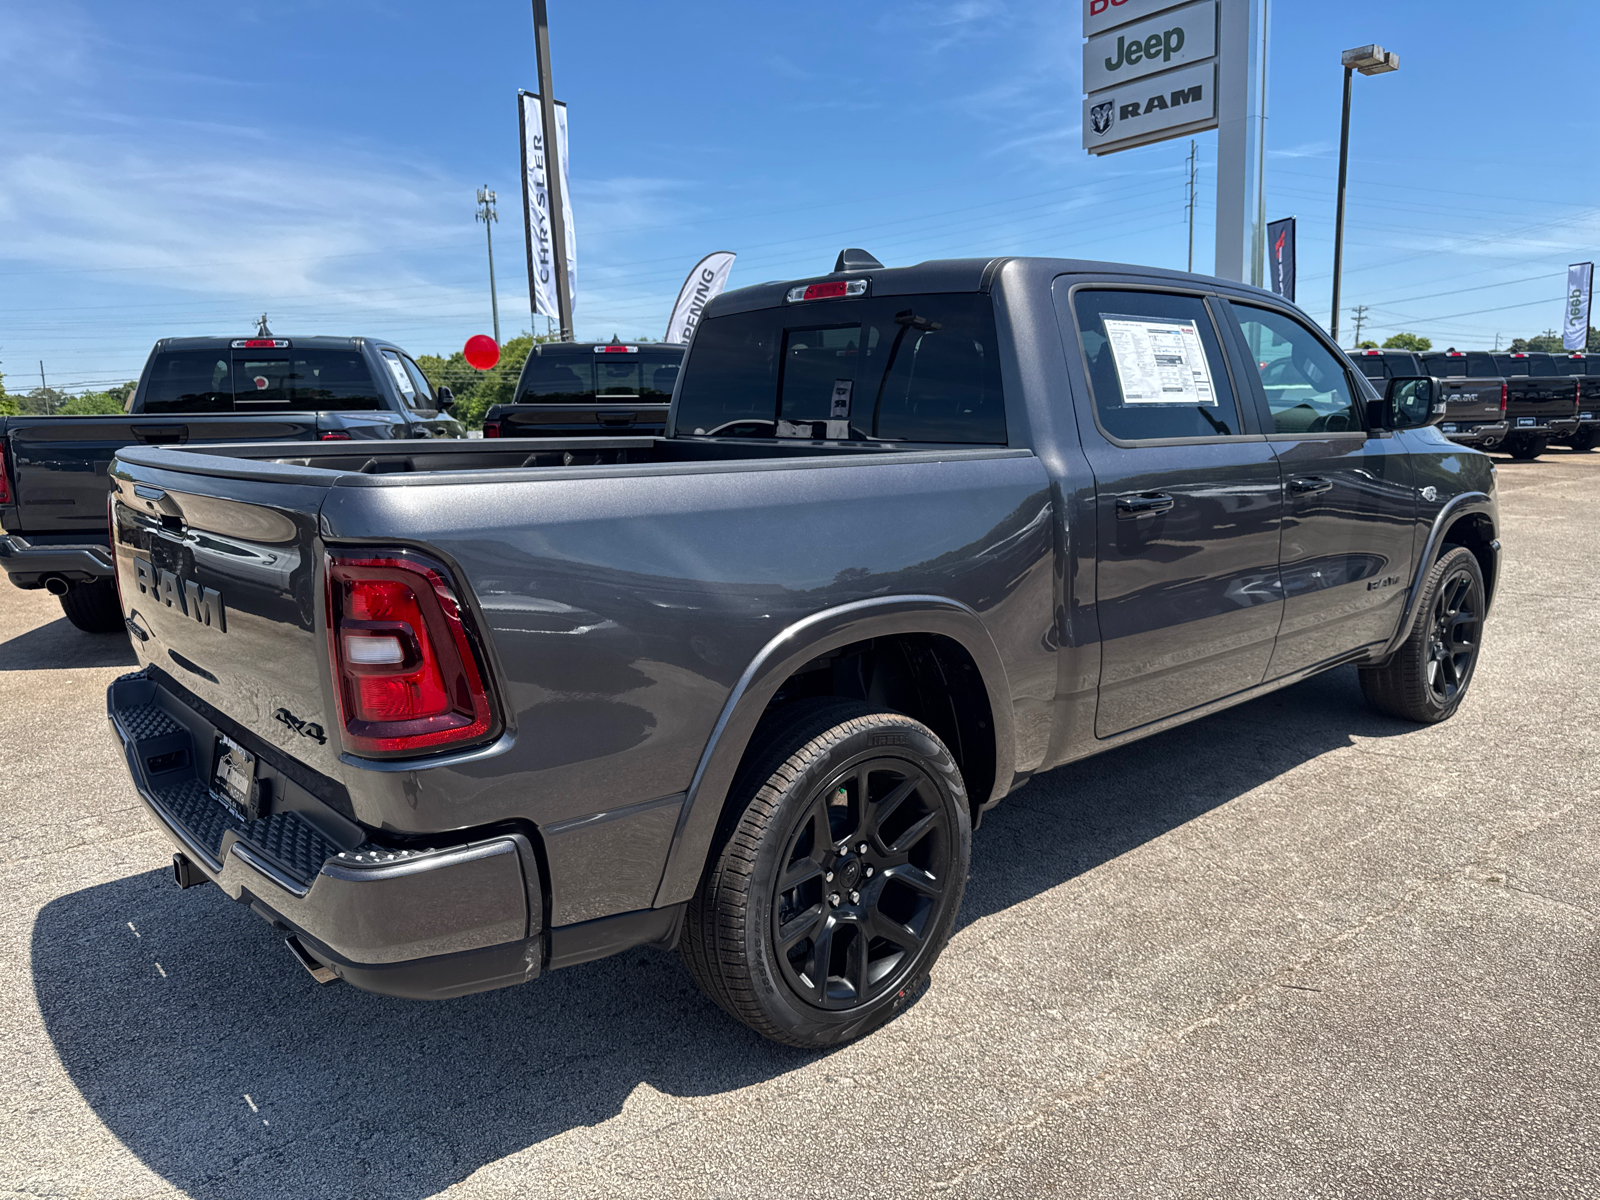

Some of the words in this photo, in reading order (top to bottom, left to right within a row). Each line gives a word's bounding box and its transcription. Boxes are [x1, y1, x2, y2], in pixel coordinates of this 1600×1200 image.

[1104, 27, 1185, 71] Jeep
[1119, 85, 1203, 121] RAM
[533, 134, 549, 285] CHRYSLER
[681, 268, 715, 344] PENING
[134, 556, 227, 633] RAM
[1367, 574, 1400, 591] RAM
